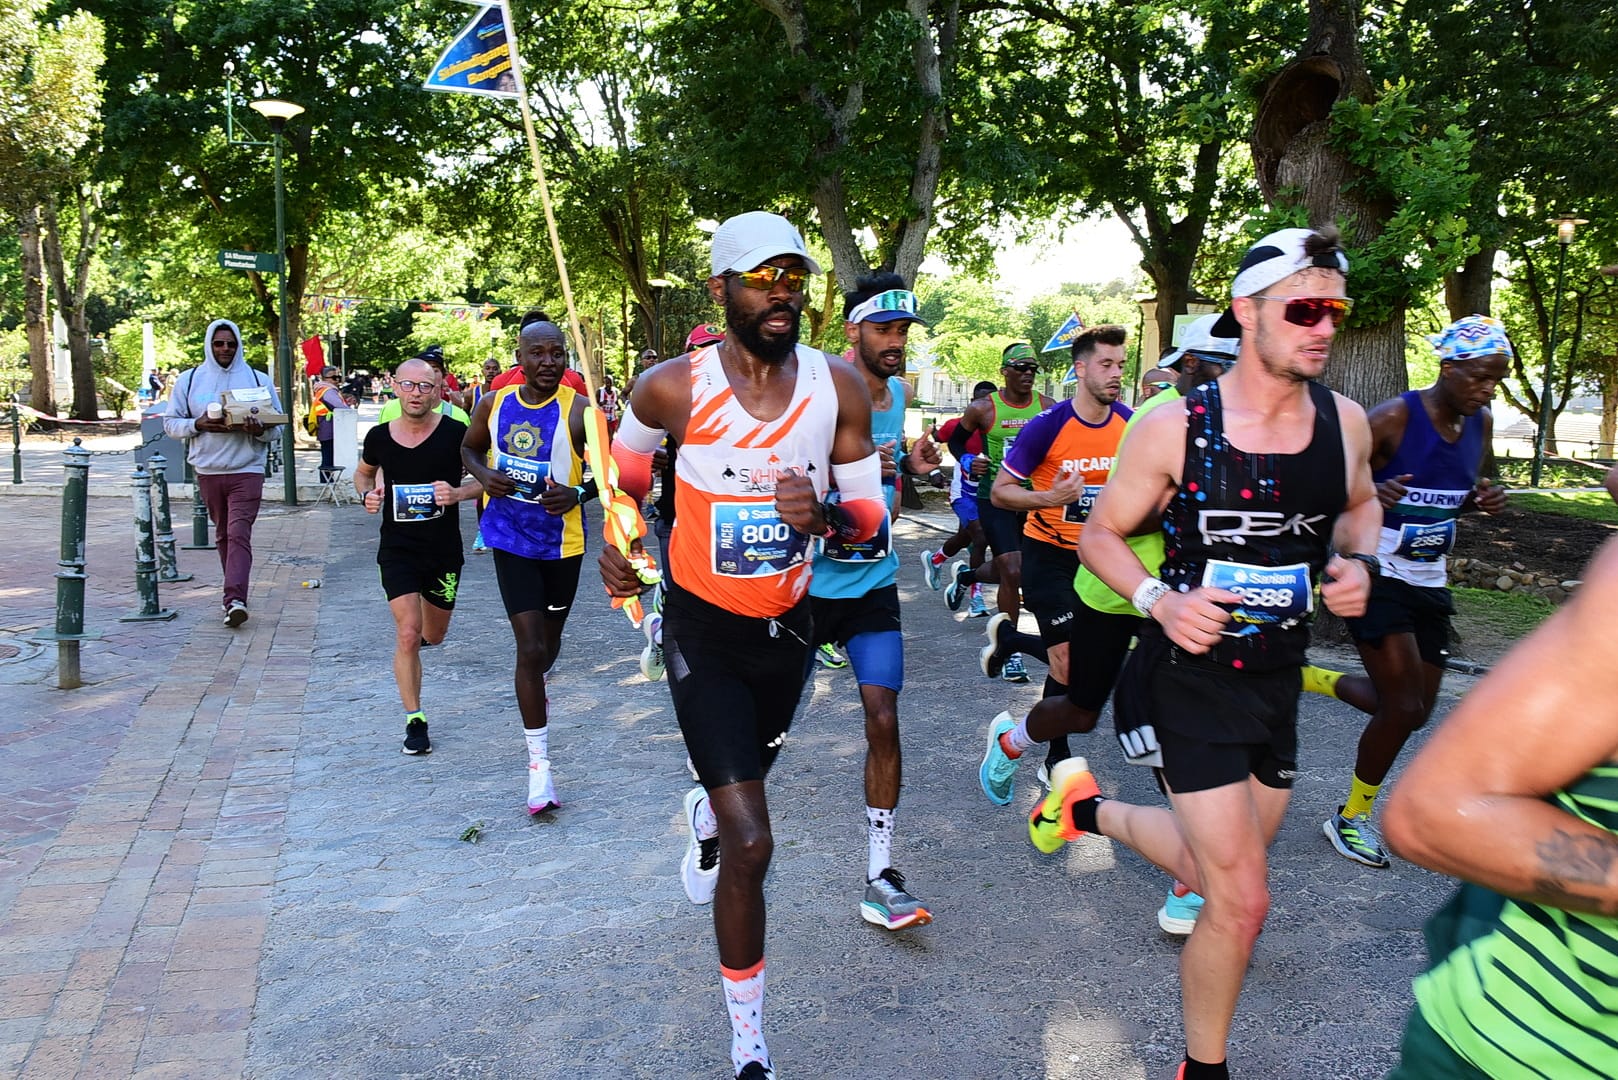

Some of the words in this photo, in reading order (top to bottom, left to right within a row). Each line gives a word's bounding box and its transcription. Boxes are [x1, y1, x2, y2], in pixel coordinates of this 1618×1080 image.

[505, 467, 537, 484] 2630
[406, 494, 432, 505] 1762
[1078, 496, 1096, 507] 131
[720, 522, 734, 549] PACER
[741, 523, 790, 544] 800
[1249, 572, 1297, 585] Sanlam
